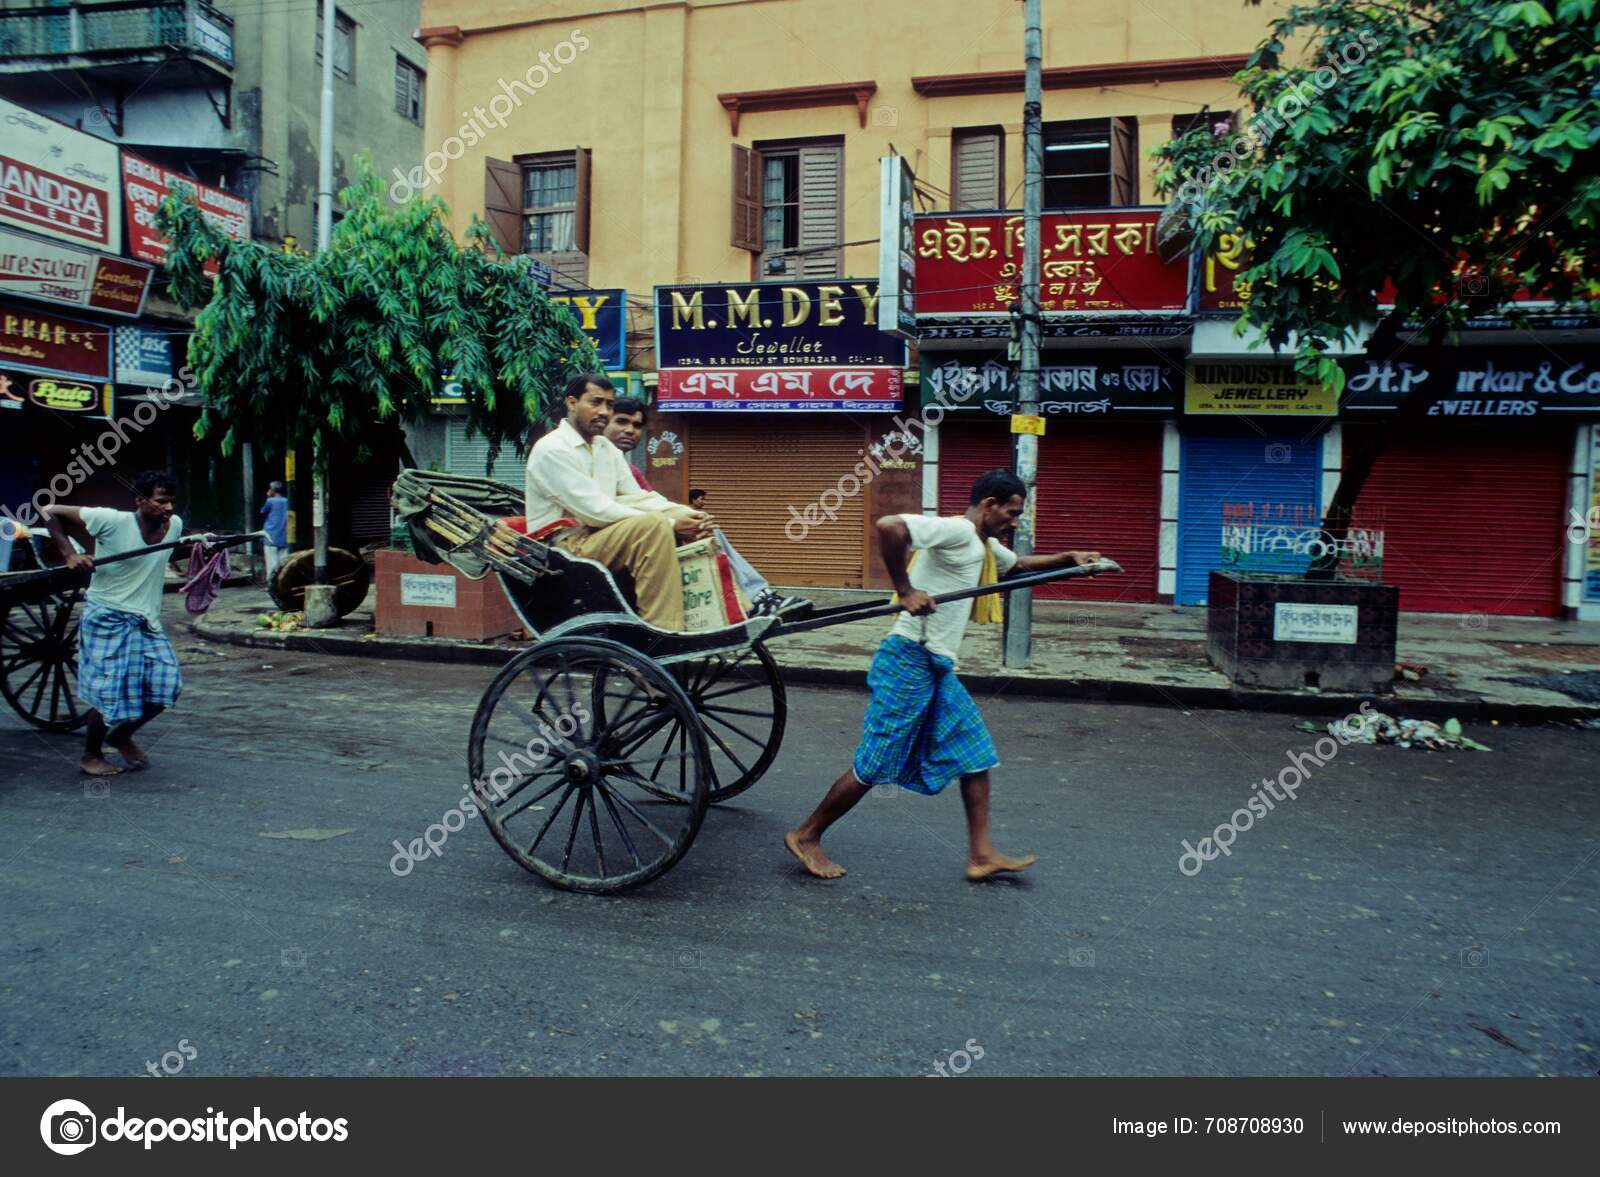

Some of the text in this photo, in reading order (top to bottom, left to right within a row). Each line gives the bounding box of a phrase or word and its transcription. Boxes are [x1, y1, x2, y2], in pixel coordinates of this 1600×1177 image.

[1055, 223, 1155, 257] সরকা
[41, 283, 80, 300] STORES
[783, 355, 838, 364] BOWBAZAR
[33, 382, 92, 402] Bata
[829, 371, 875, 396] দে
[1214, 387, 1309, 400] JEWELLERY
